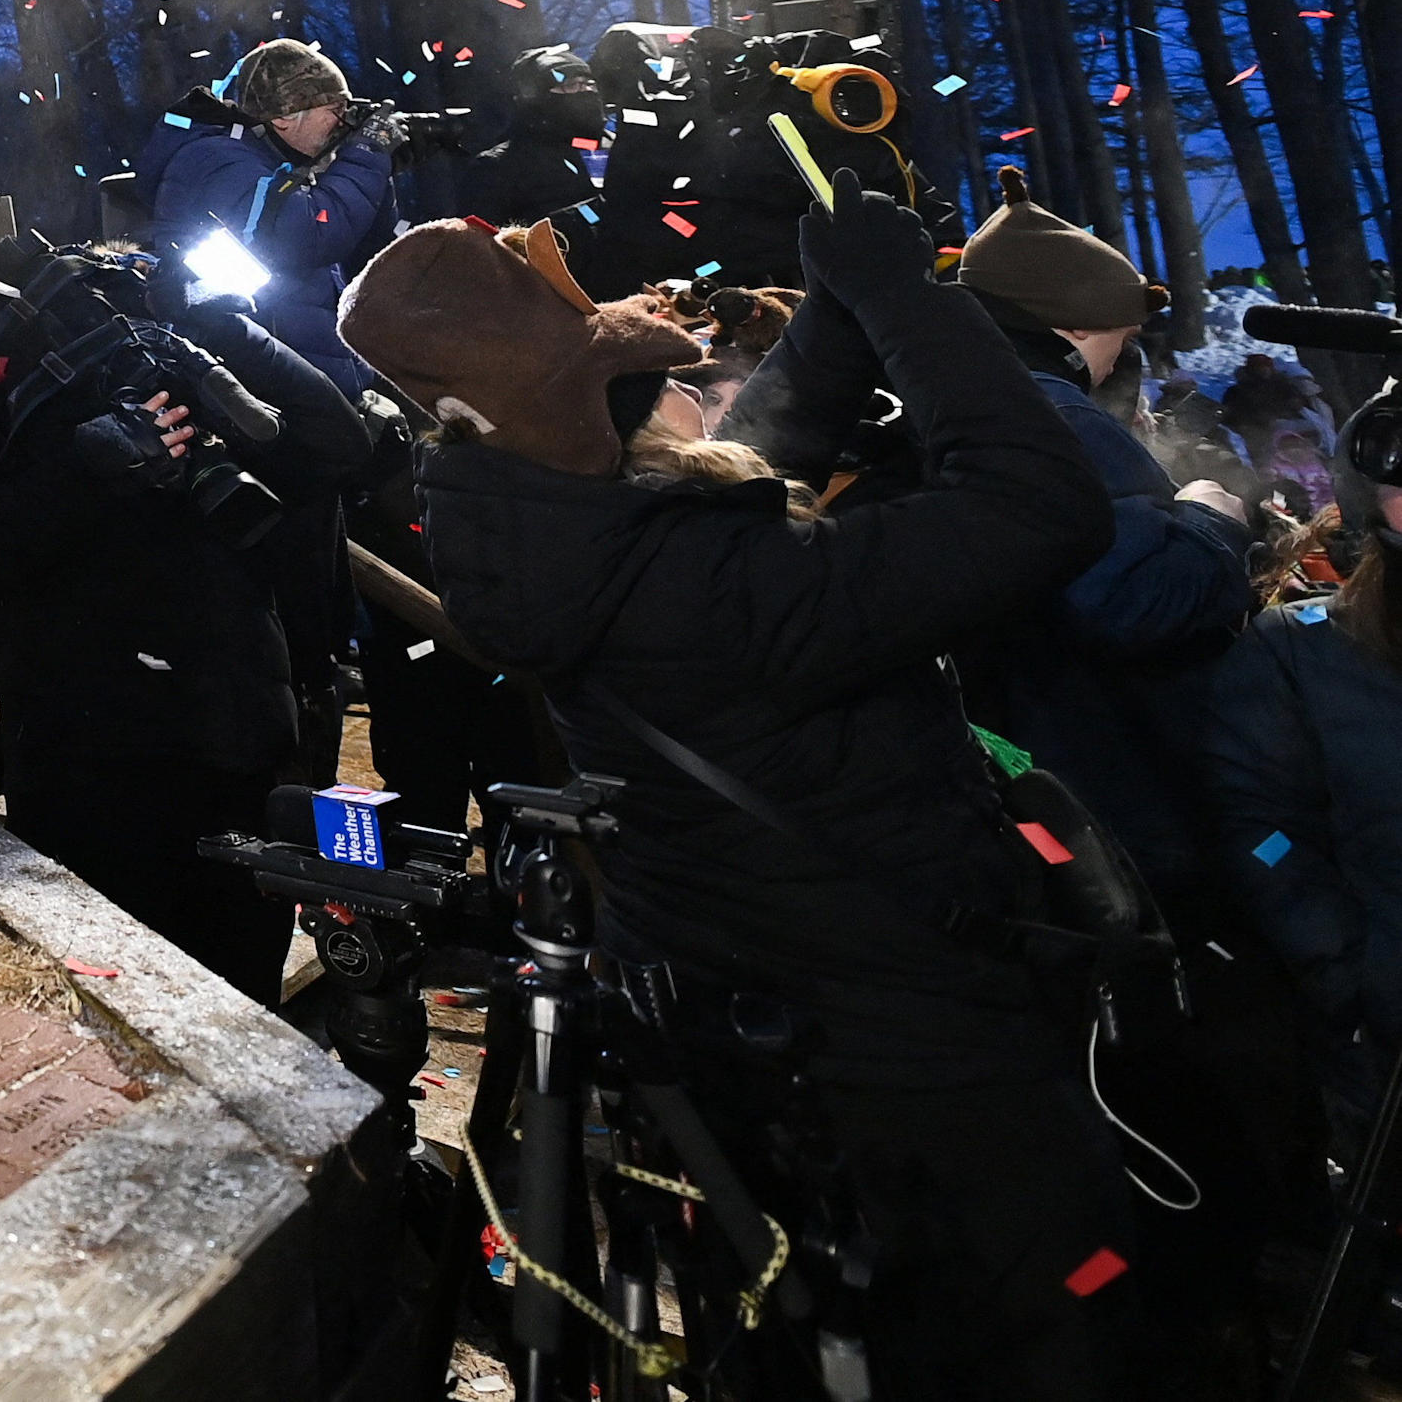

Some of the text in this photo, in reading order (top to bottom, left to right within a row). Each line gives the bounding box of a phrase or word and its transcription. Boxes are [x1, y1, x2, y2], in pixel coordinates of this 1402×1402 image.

[333, 832, 348, 859] The
[344, 802, 363, 862] Weather
[356, 807, 378, 866] Channel
